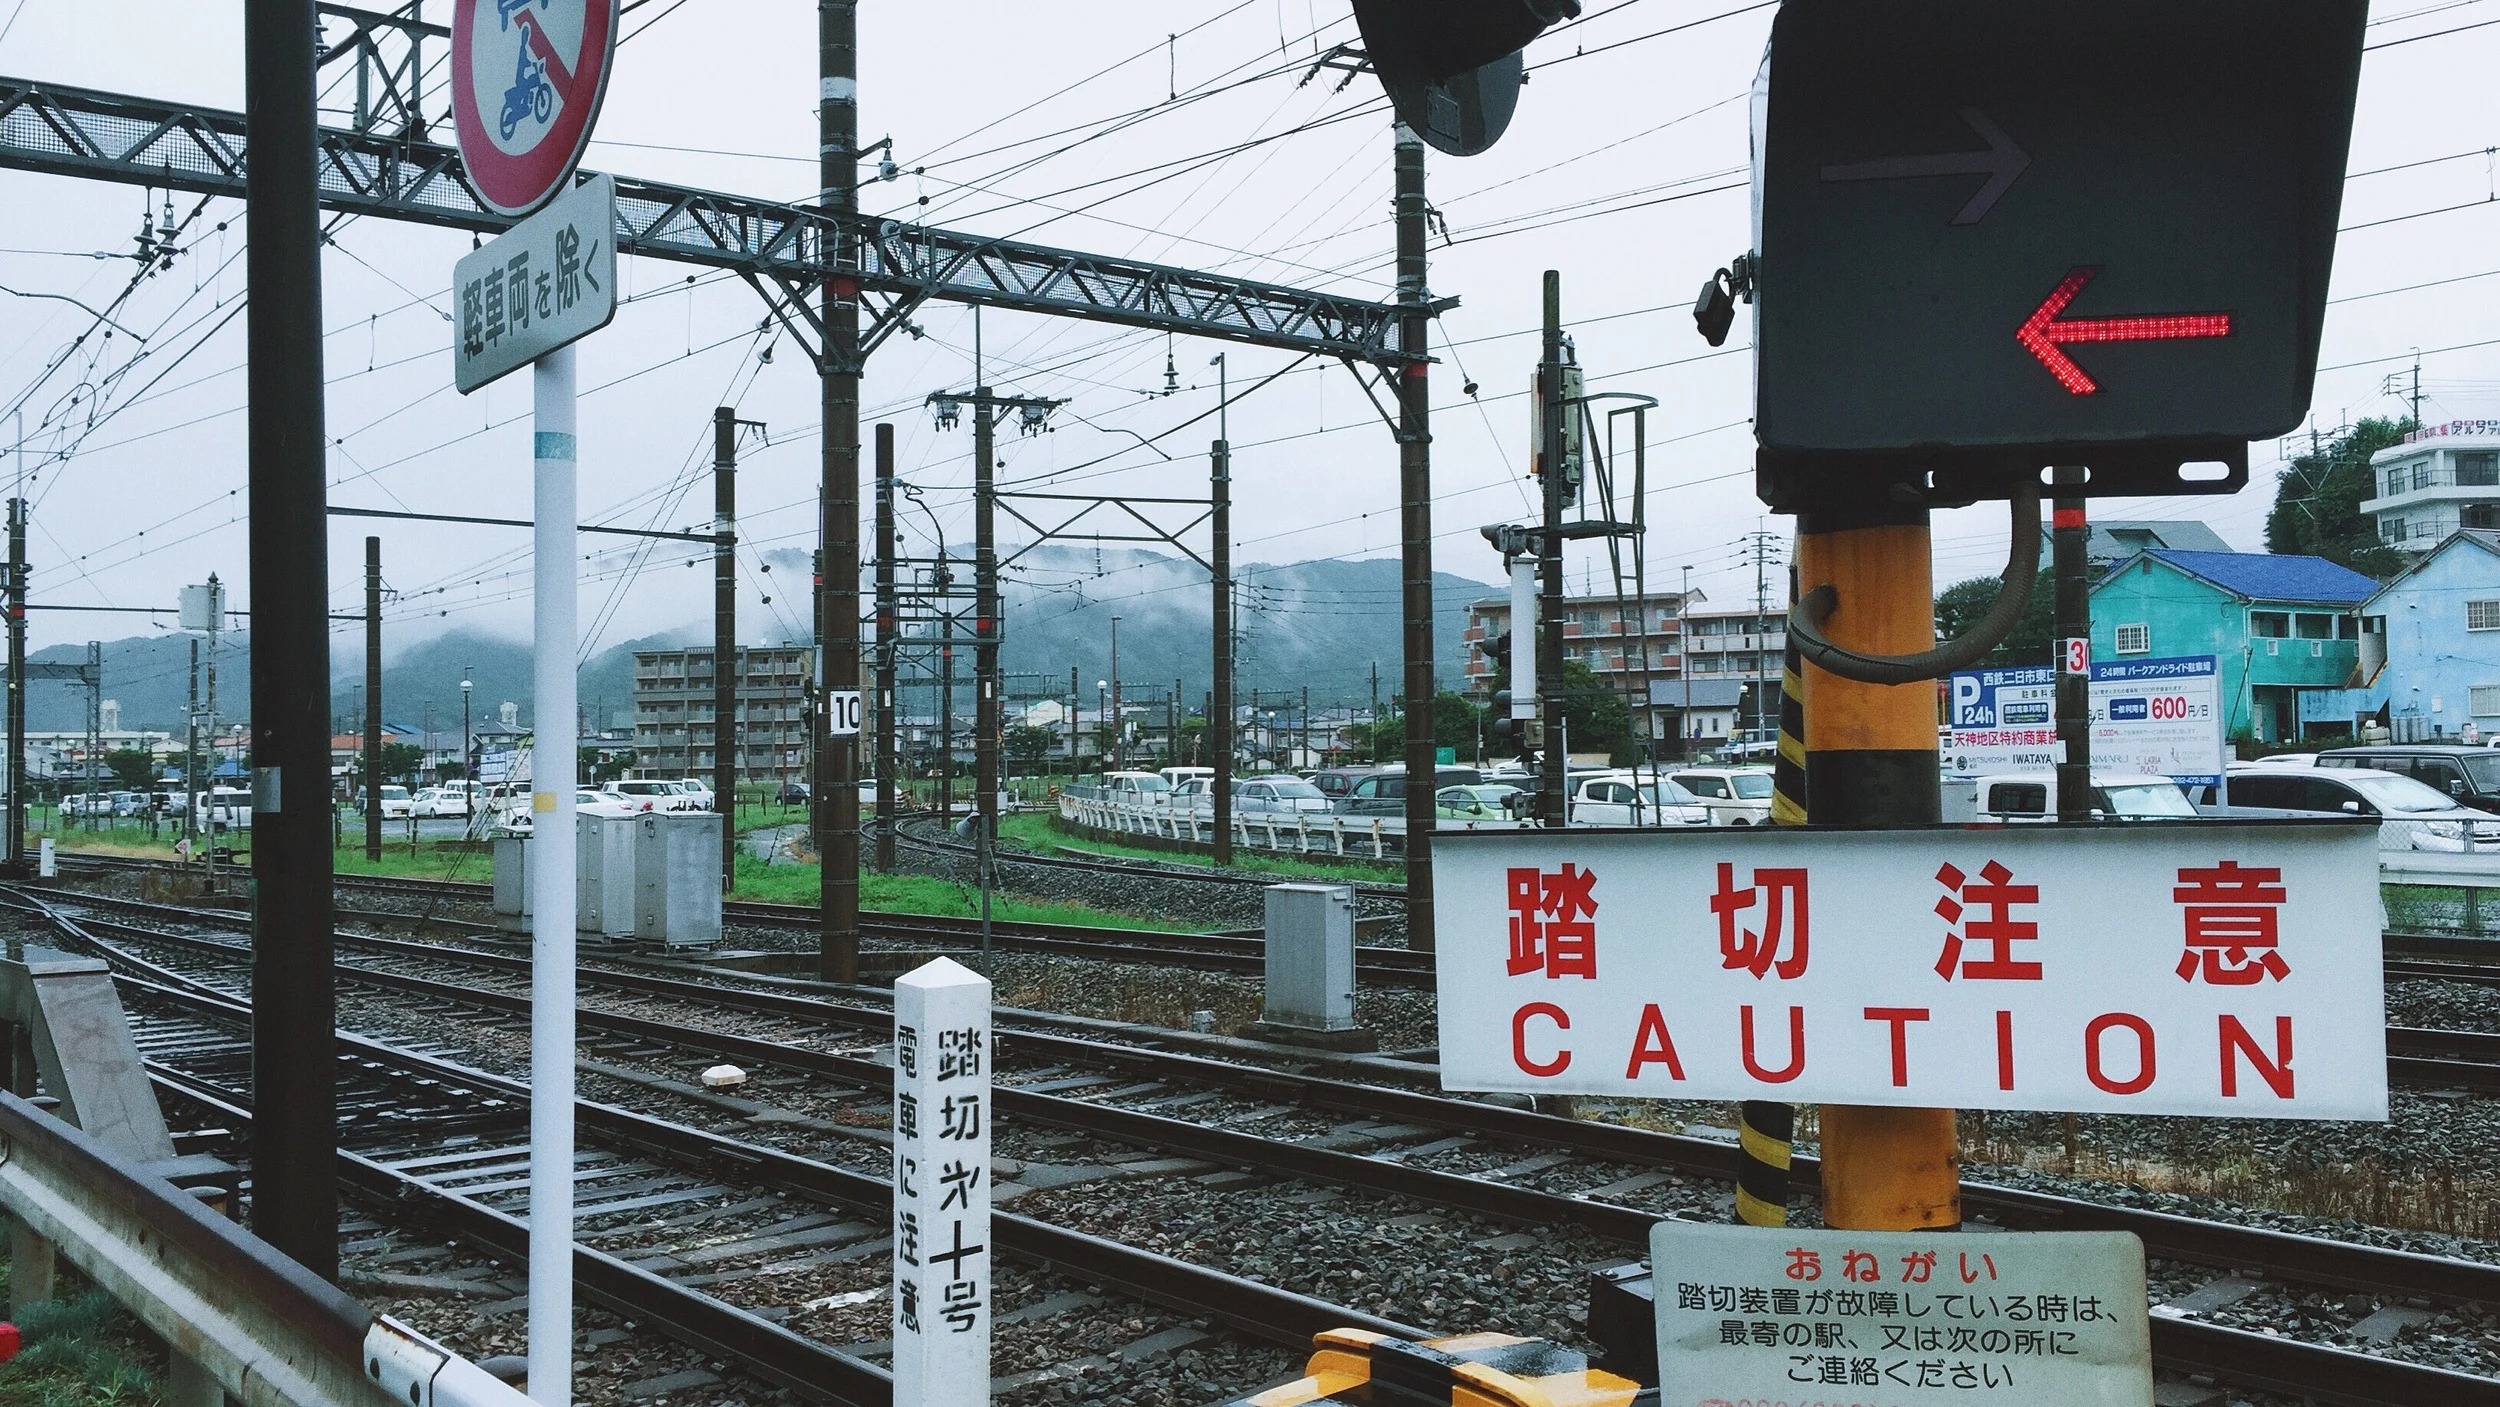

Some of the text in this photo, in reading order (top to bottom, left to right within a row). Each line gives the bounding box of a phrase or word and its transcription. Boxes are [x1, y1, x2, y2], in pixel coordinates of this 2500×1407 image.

[462, 223, 600, 362] 軽車両を除く
[2070, 641, 2089, 671] 3
[836, 696, 860, 729] 10
[1953, 676, 1981, 725] P
[1965, 706, 1994, 724] 24h
[2012, 753, 2051, 764] IWATAYA
[1506, 858, 2291, 987] 踏切注意
[1511, 1001, 2295, 1101] CAUTION
[897, 1024, 921, 1336] 電車に注意
[1785, 1247, 1998, 1284] おねがい
[1677, 1282, 2119, 1324] 踏切装置が故障している時は、
[1718, 1319, 2080, 1357] 最寄の駅、又は次の所に
[1787, 1354, 2014, 1390] ご連絡ください
